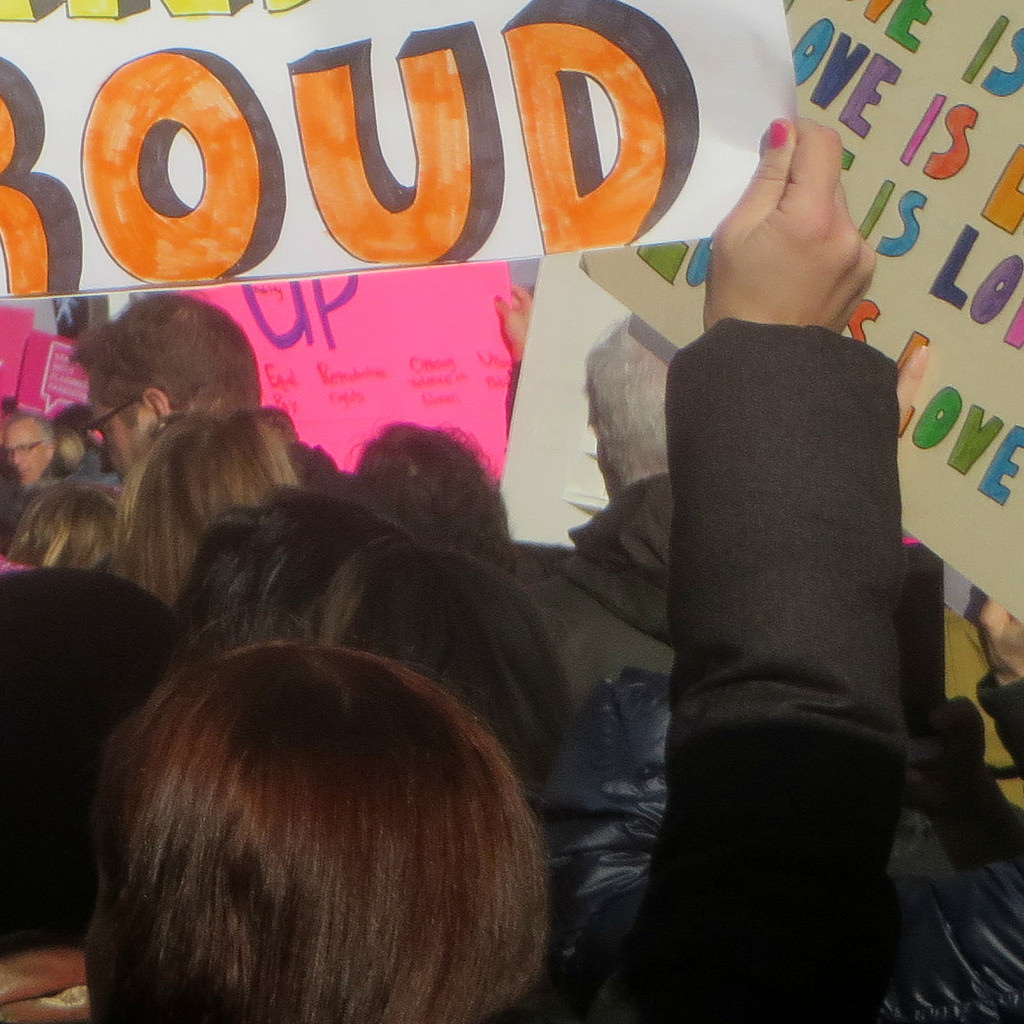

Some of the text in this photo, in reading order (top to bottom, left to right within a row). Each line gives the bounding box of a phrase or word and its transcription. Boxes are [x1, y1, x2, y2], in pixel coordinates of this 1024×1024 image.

[961, 15, 1024, 98] IS
[900, 94, 979, 180] IS
[858, 180, 928, 257] IS
